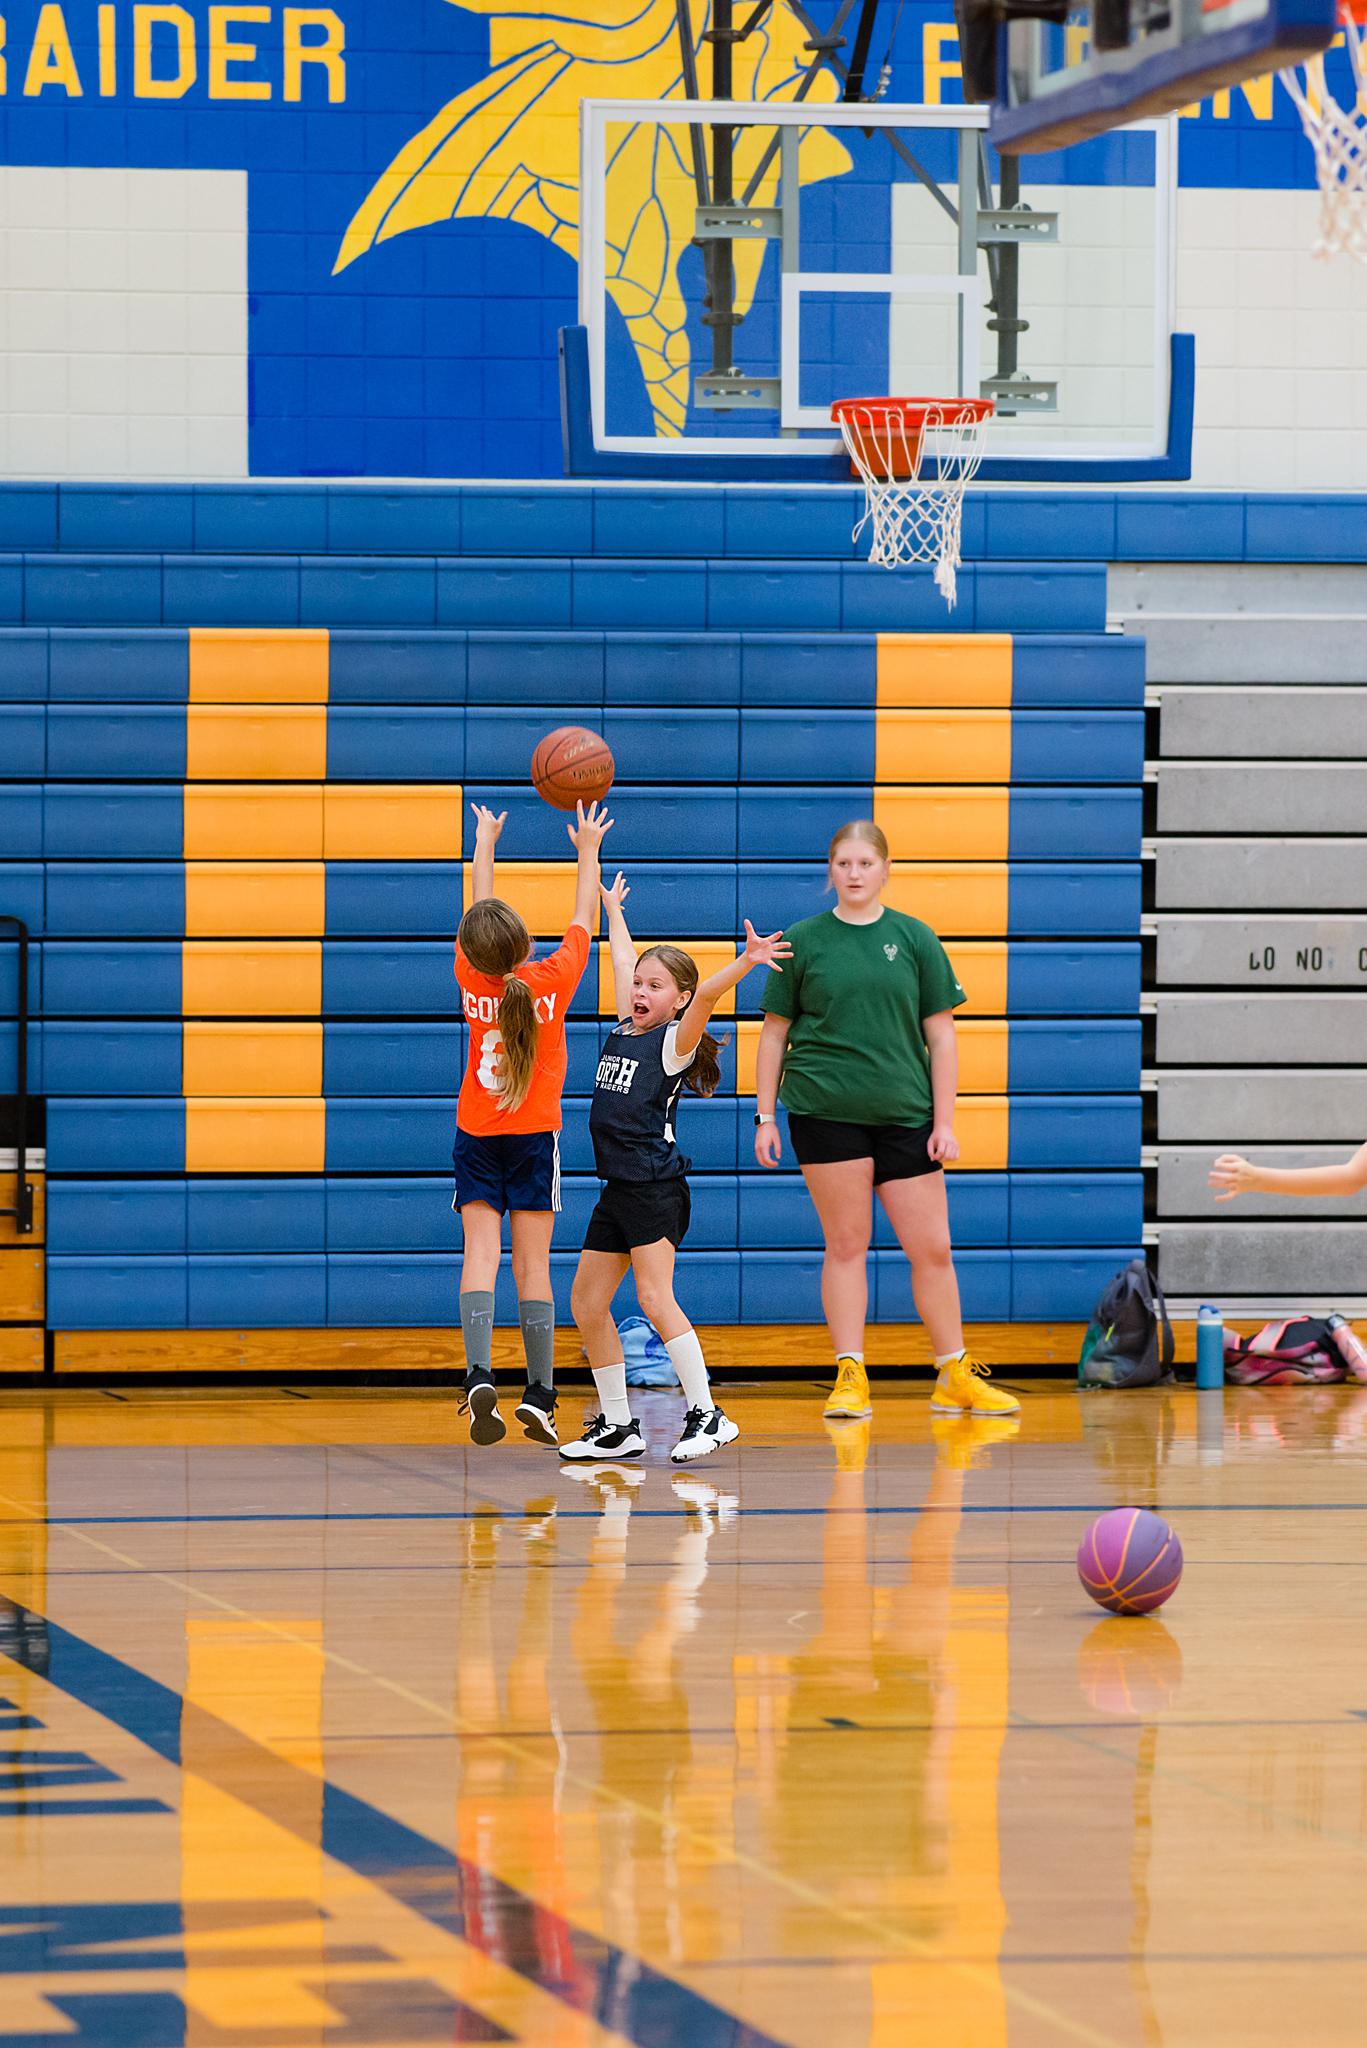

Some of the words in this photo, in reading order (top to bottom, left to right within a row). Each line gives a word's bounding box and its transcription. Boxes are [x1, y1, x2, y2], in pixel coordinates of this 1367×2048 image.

[0, 3, 346, 104] AIDER
[1296, 947, 1334, 971] NO
[463, 988, 557, 1024] GOKY
[596, 1057, 639, 1087] ORTH
[601, 1054, 621, 1063] JUNIOR
[600, 1082, 630, 1094] RAIDERS
